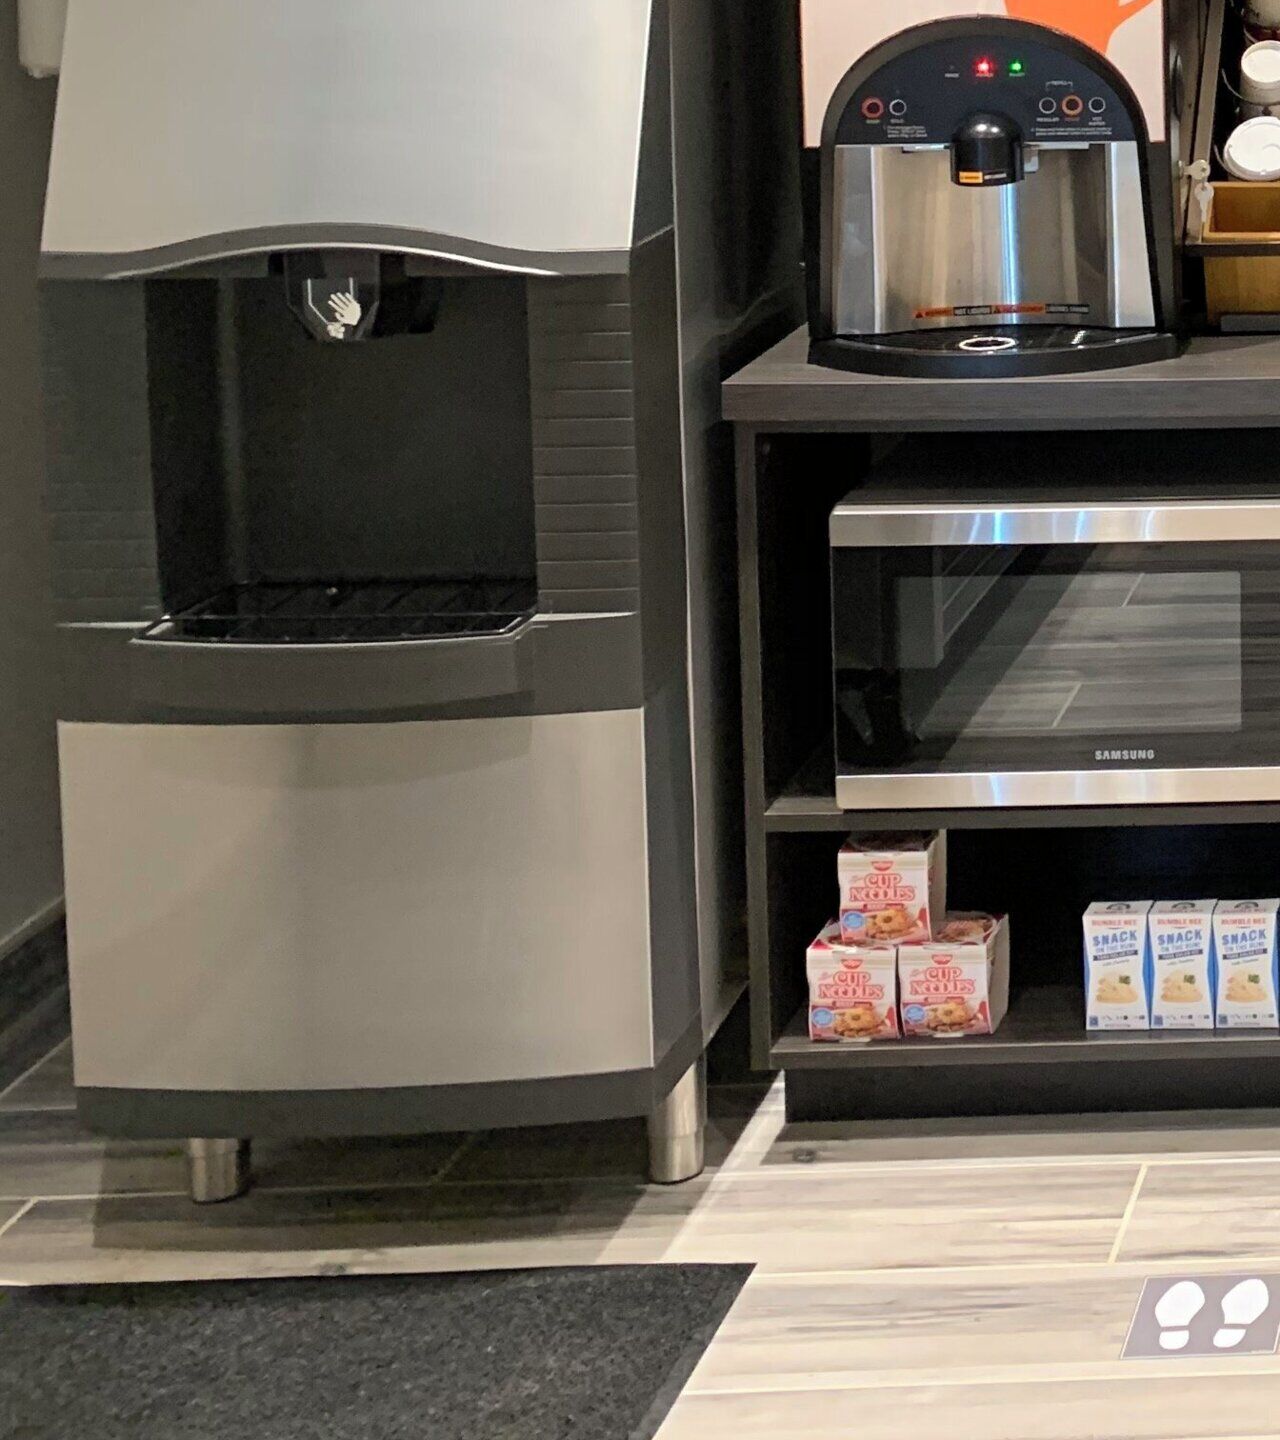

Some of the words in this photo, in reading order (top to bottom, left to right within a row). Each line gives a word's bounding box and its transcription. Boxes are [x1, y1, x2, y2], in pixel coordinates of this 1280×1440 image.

[1095, 749, 1155, 761] SAMSUNG
[865, 873, 902, 888] CUP
[850, 886, 916, 901] NOODLES
[1092, 930, 1138, 947] SNACK
[1157, 929, 1202, 946] SNACK
[1222, 929, 1267, 945] SNACK
[832, 971, 870, 986] CUP
[925, 967, 962, 982] CUP
[819, 984, 884, 1000] NOODLES
[910, 979, 975, 995] NOODLES
